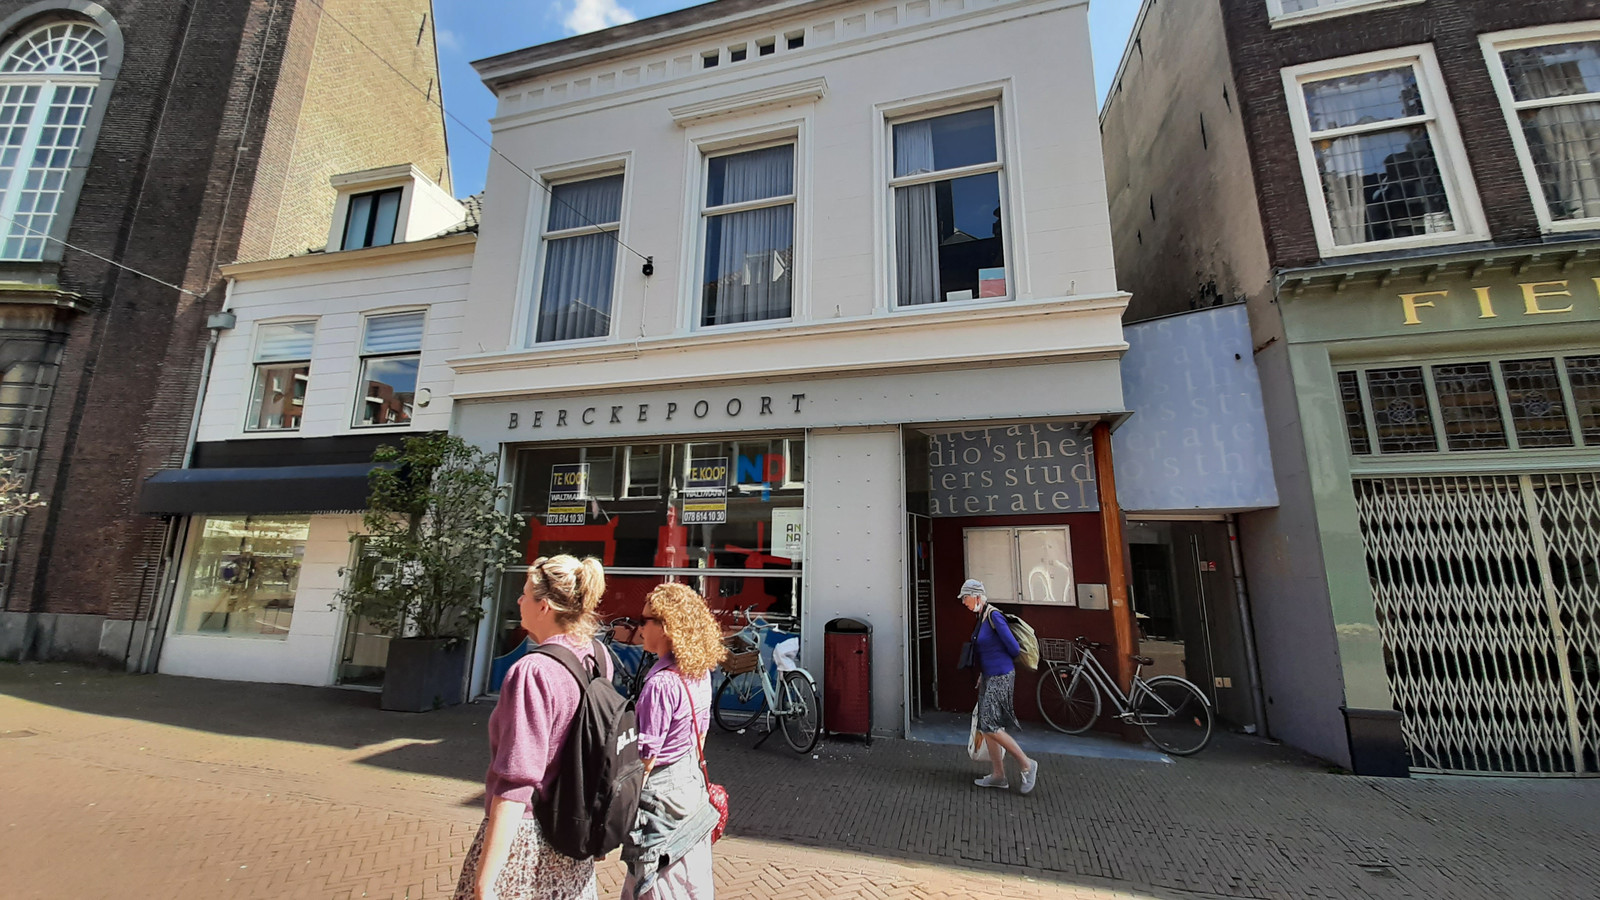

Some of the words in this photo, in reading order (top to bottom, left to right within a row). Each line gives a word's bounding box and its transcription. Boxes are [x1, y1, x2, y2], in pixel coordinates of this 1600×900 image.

[508, 393, 805, 429] BERCKEPOORT
[553, 472, 563, 485] TE
[700, 466, 726, 480] KOOP
[1010, 478, 1099, 513] atel
[684, 511, 696, 521] 078
[696, 511, 708, 521] 614
[708, 511, 716, 520] 10
[716, 511, 725, 520] 30
